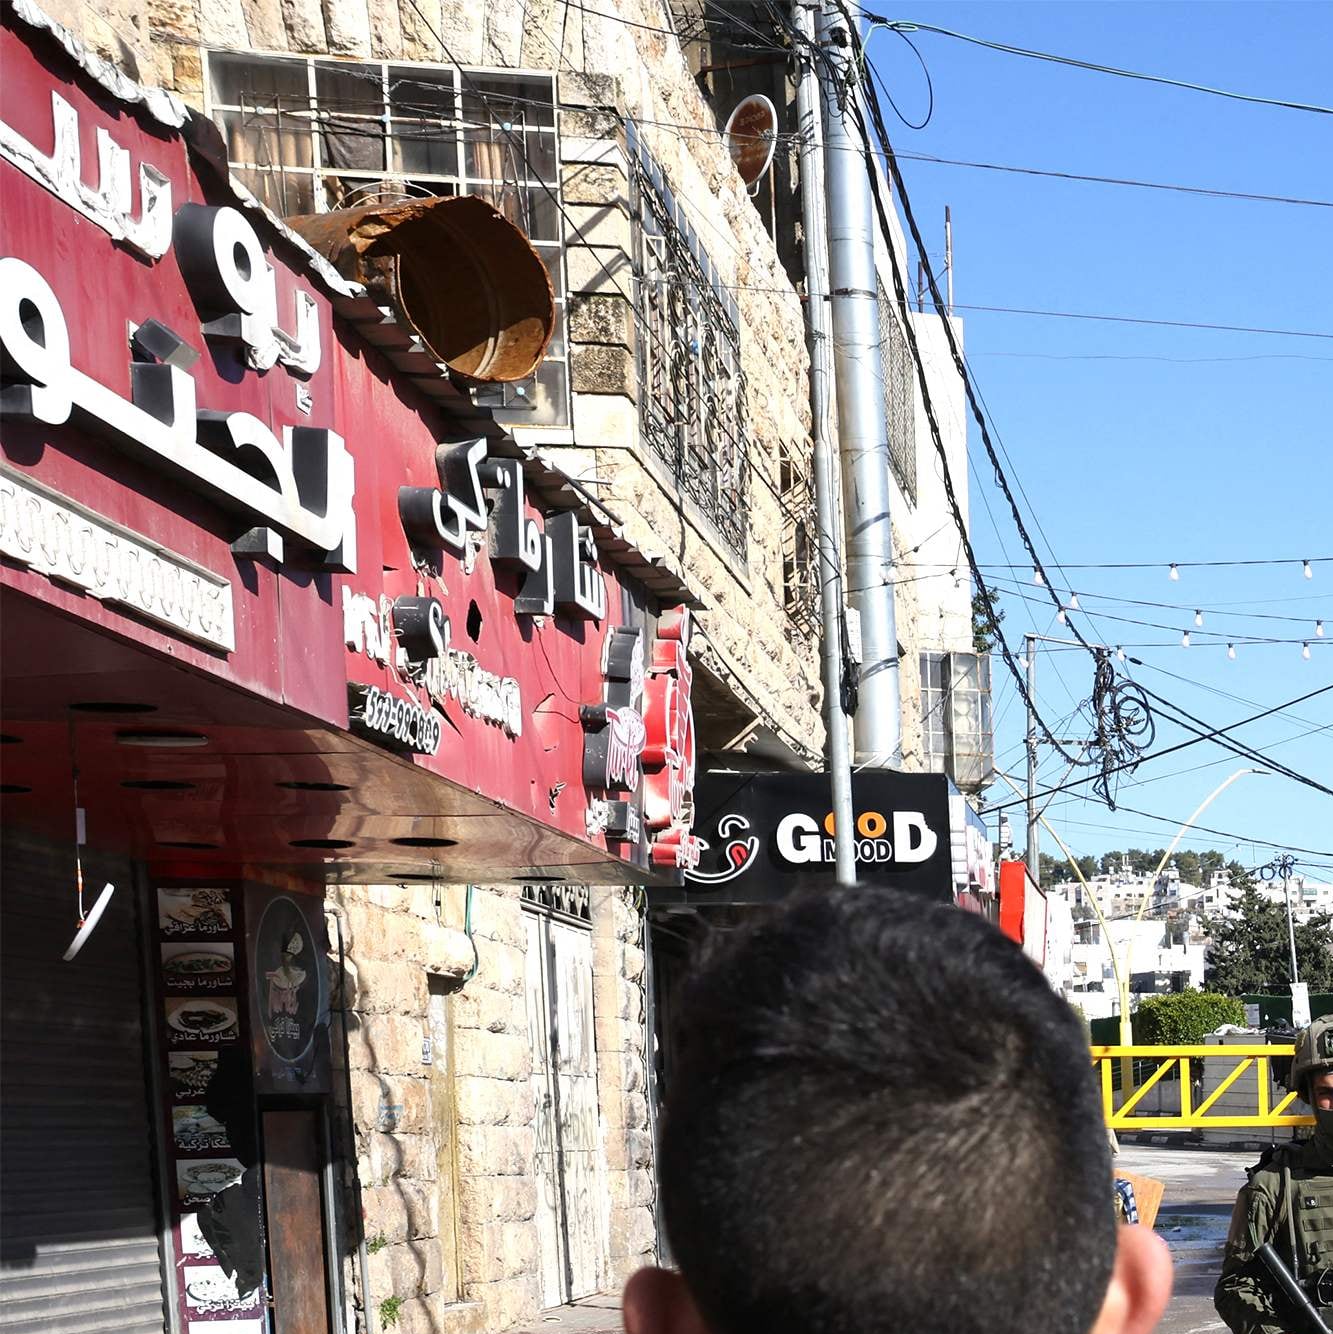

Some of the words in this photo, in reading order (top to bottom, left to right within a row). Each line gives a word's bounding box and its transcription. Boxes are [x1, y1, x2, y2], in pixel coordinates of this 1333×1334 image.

[199, 921, 229, 933] شاورما
[197, 975, 233, 988] شاورما
[199, 1030, 237, 1043] شاورما
